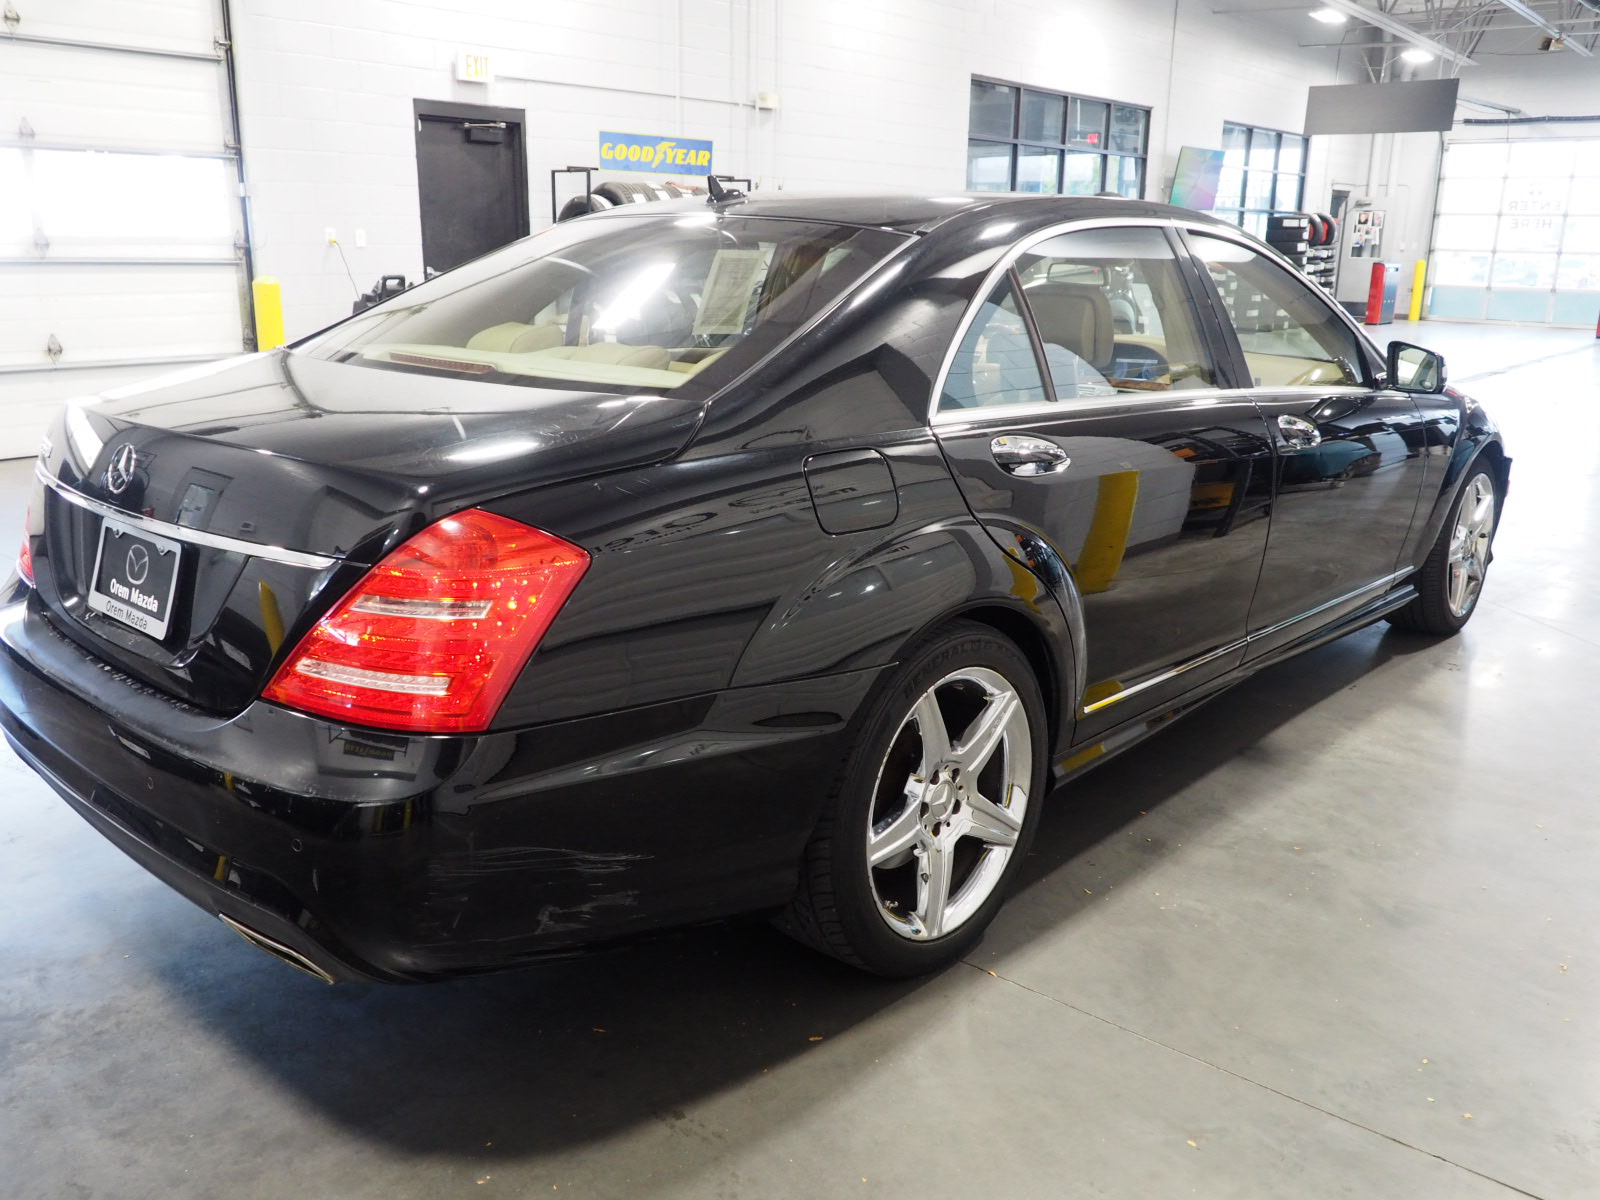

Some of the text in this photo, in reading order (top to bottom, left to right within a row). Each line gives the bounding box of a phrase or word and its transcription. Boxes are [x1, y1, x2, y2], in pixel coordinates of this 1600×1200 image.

[465, 54, 489, 79] EXIT
[601, 141, 711, 168] GOODYEAR
[110, 578, 158, 612] Orem Mazda
[106, 600, 147, 630] Orem Mazda
